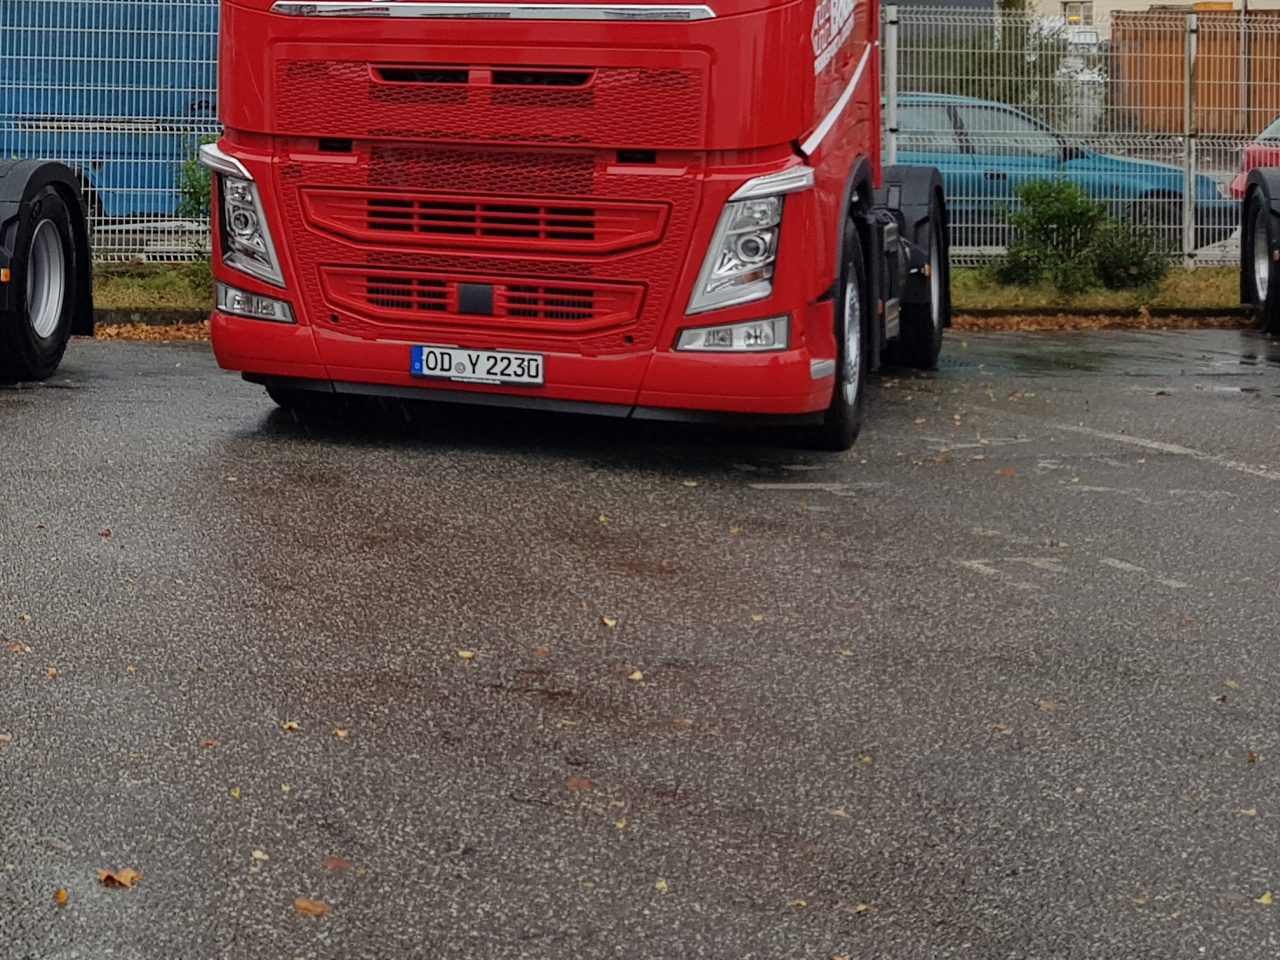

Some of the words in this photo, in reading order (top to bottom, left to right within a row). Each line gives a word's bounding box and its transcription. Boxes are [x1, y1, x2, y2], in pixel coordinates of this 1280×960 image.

[425, 351, 452, 372] OD
[467, 353, 480, 374] Y
[486, 355, 540, 378] 2230
